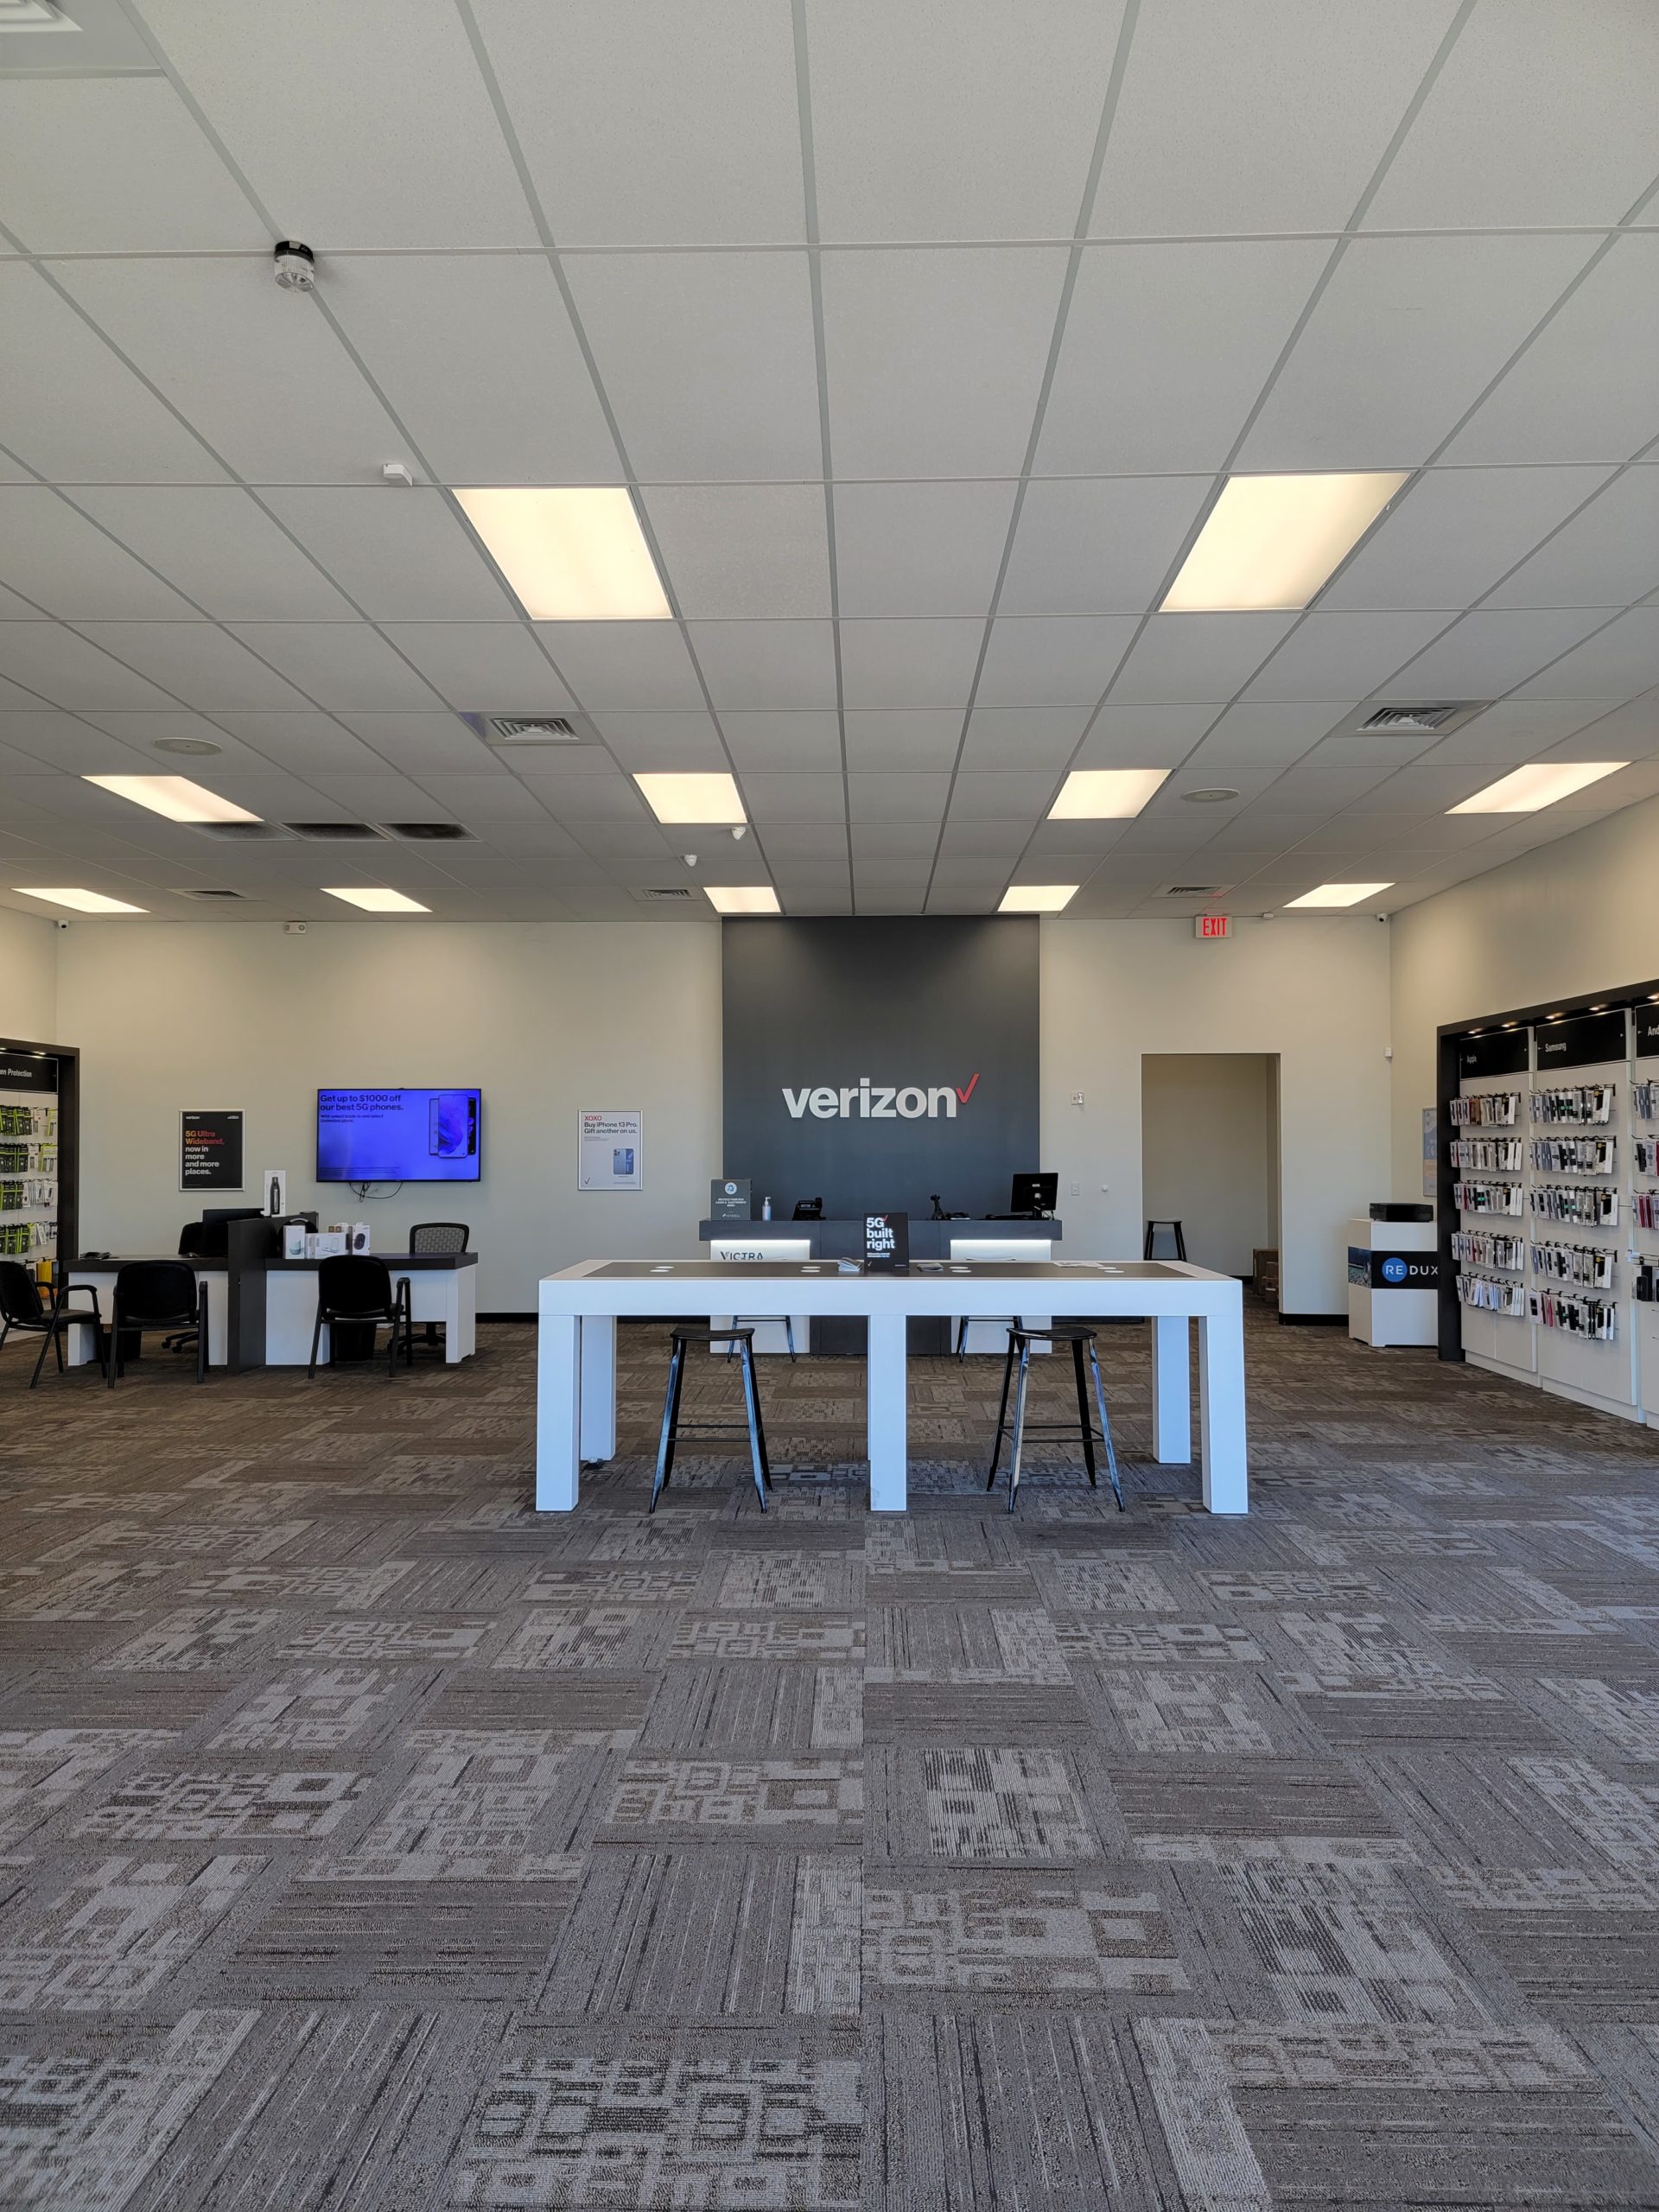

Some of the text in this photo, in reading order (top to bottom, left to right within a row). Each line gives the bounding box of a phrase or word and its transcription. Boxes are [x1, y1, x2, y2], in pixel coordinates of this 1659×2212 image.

[1203, 917, 1227, 937] EXIT
[1545, 1042, 1566, 1052] Samsung
[1466, 1054, 1477, 1064] Apple
[8, 1068, 33, 1077] Protection
[320, 1094, 335, 1103] Get
[336, 1095, 348, 1103] up
[359, 1094, 388, 1103] $1000
[389, 1094, 402, 1103] off
[781, 1077, 957, 1119] verizon
[356, 1103, 369, 1111] 5G
[370, 1103, 404, 1112] phones.
[185, 1167, 212, 1176] places.
[866, 1217, 885, 1228] 5G
[866, 1227, 893, 1238] built
[866, 1238, 895, 1251] right
[720, 1251, 764, 1261] VICTRA
